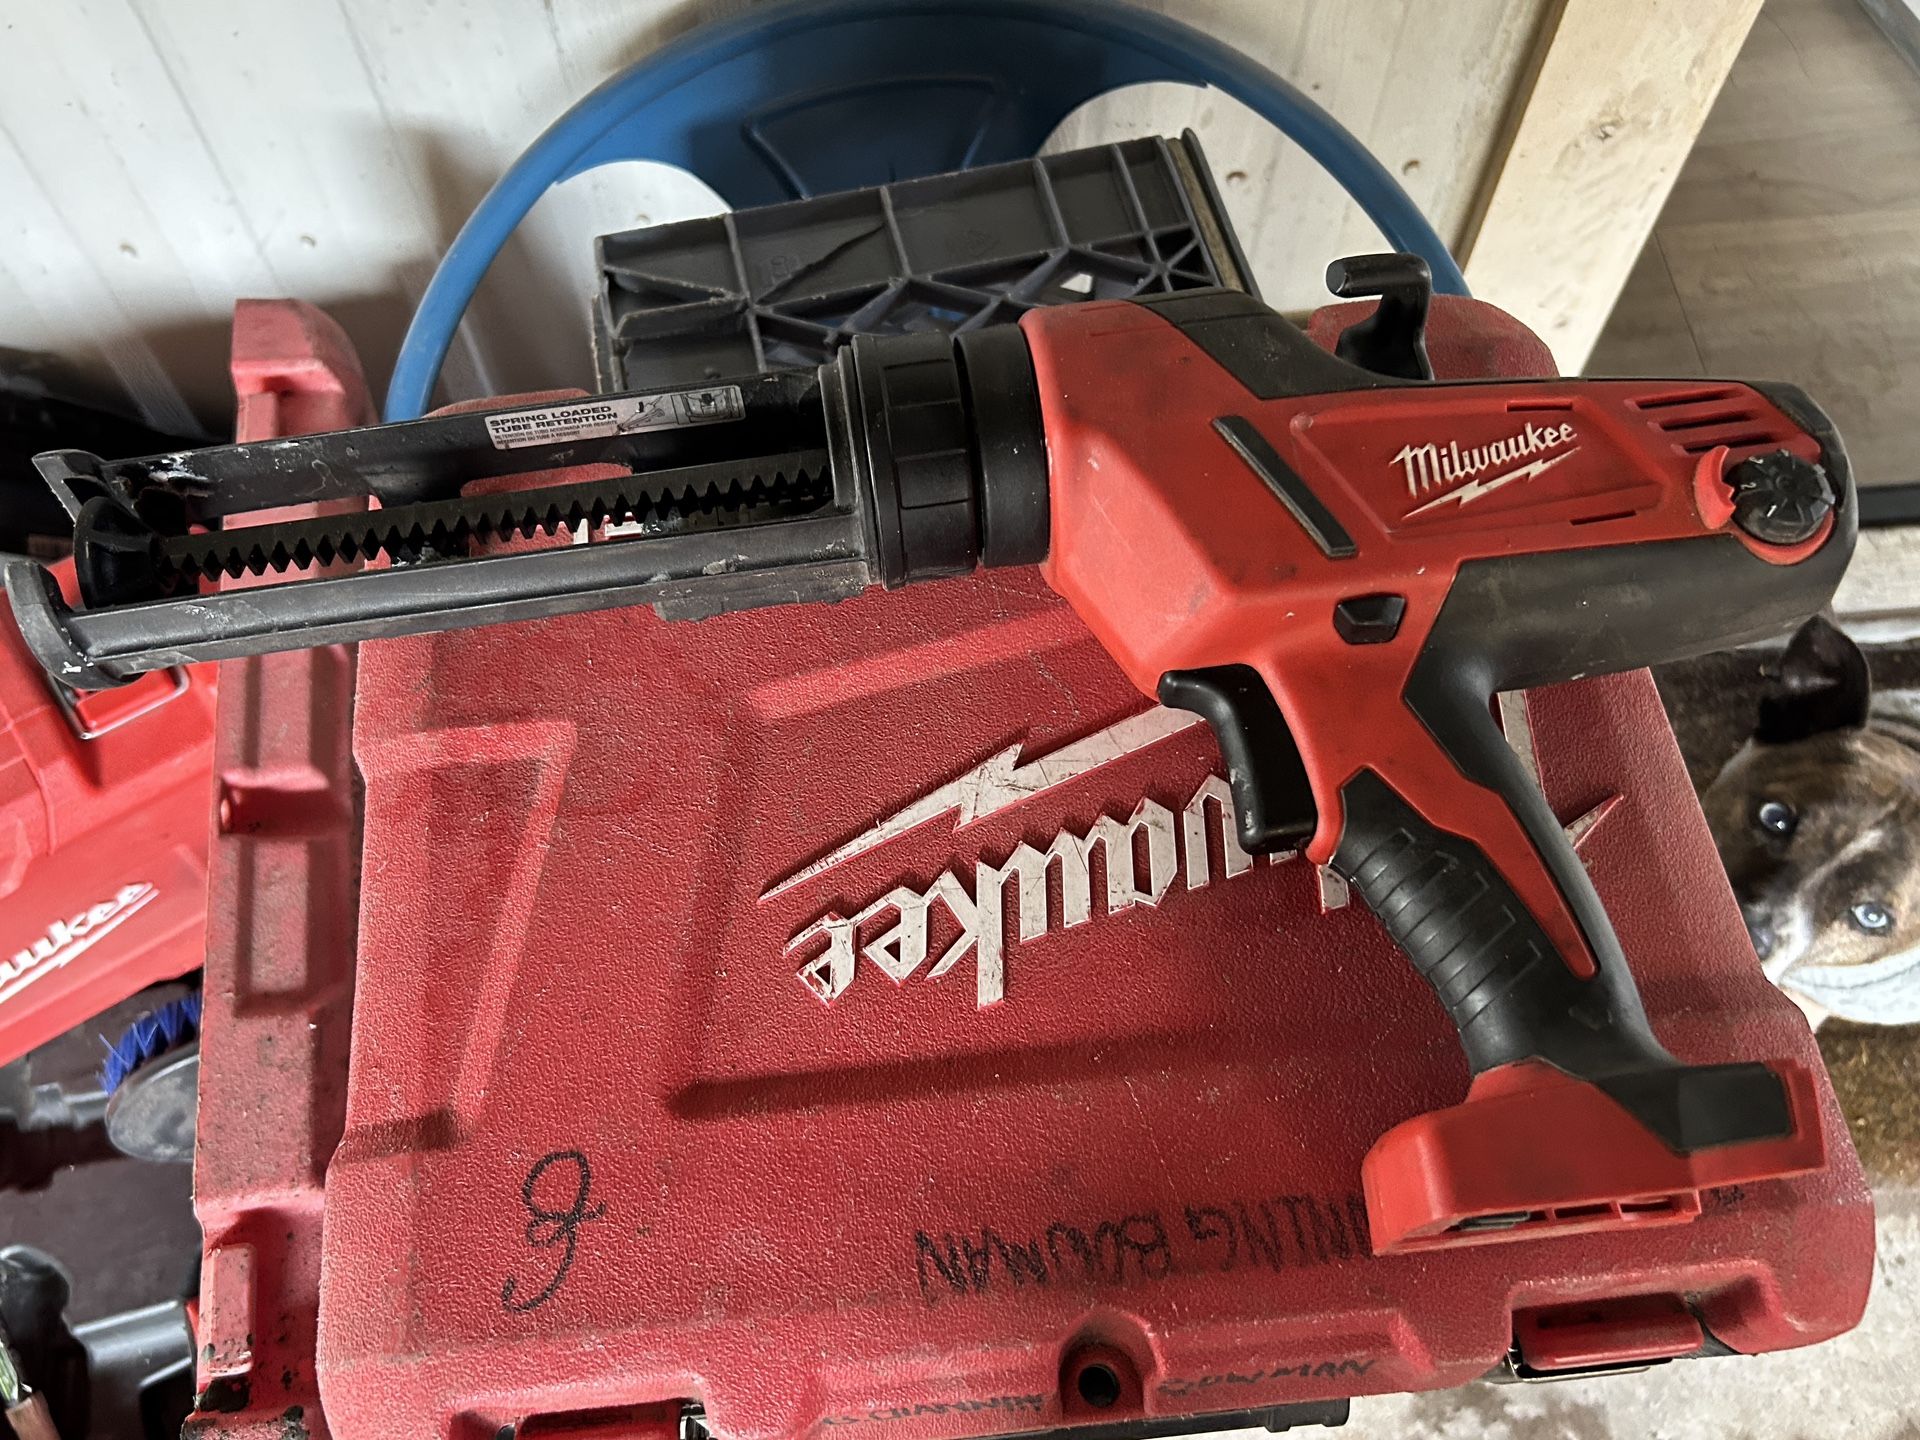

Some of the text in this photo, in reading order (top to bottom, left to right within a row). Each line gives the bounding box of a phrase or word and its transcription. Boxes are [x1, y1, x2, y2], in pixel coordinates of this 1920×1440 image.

[490, 406, 611, 427] SPRING LOADED
[492, 412, 618, 433] TUBE RETENTION
[1388, 421, 1577, 500] Milwaukee
[1766, 504, 1777, 518] 1
